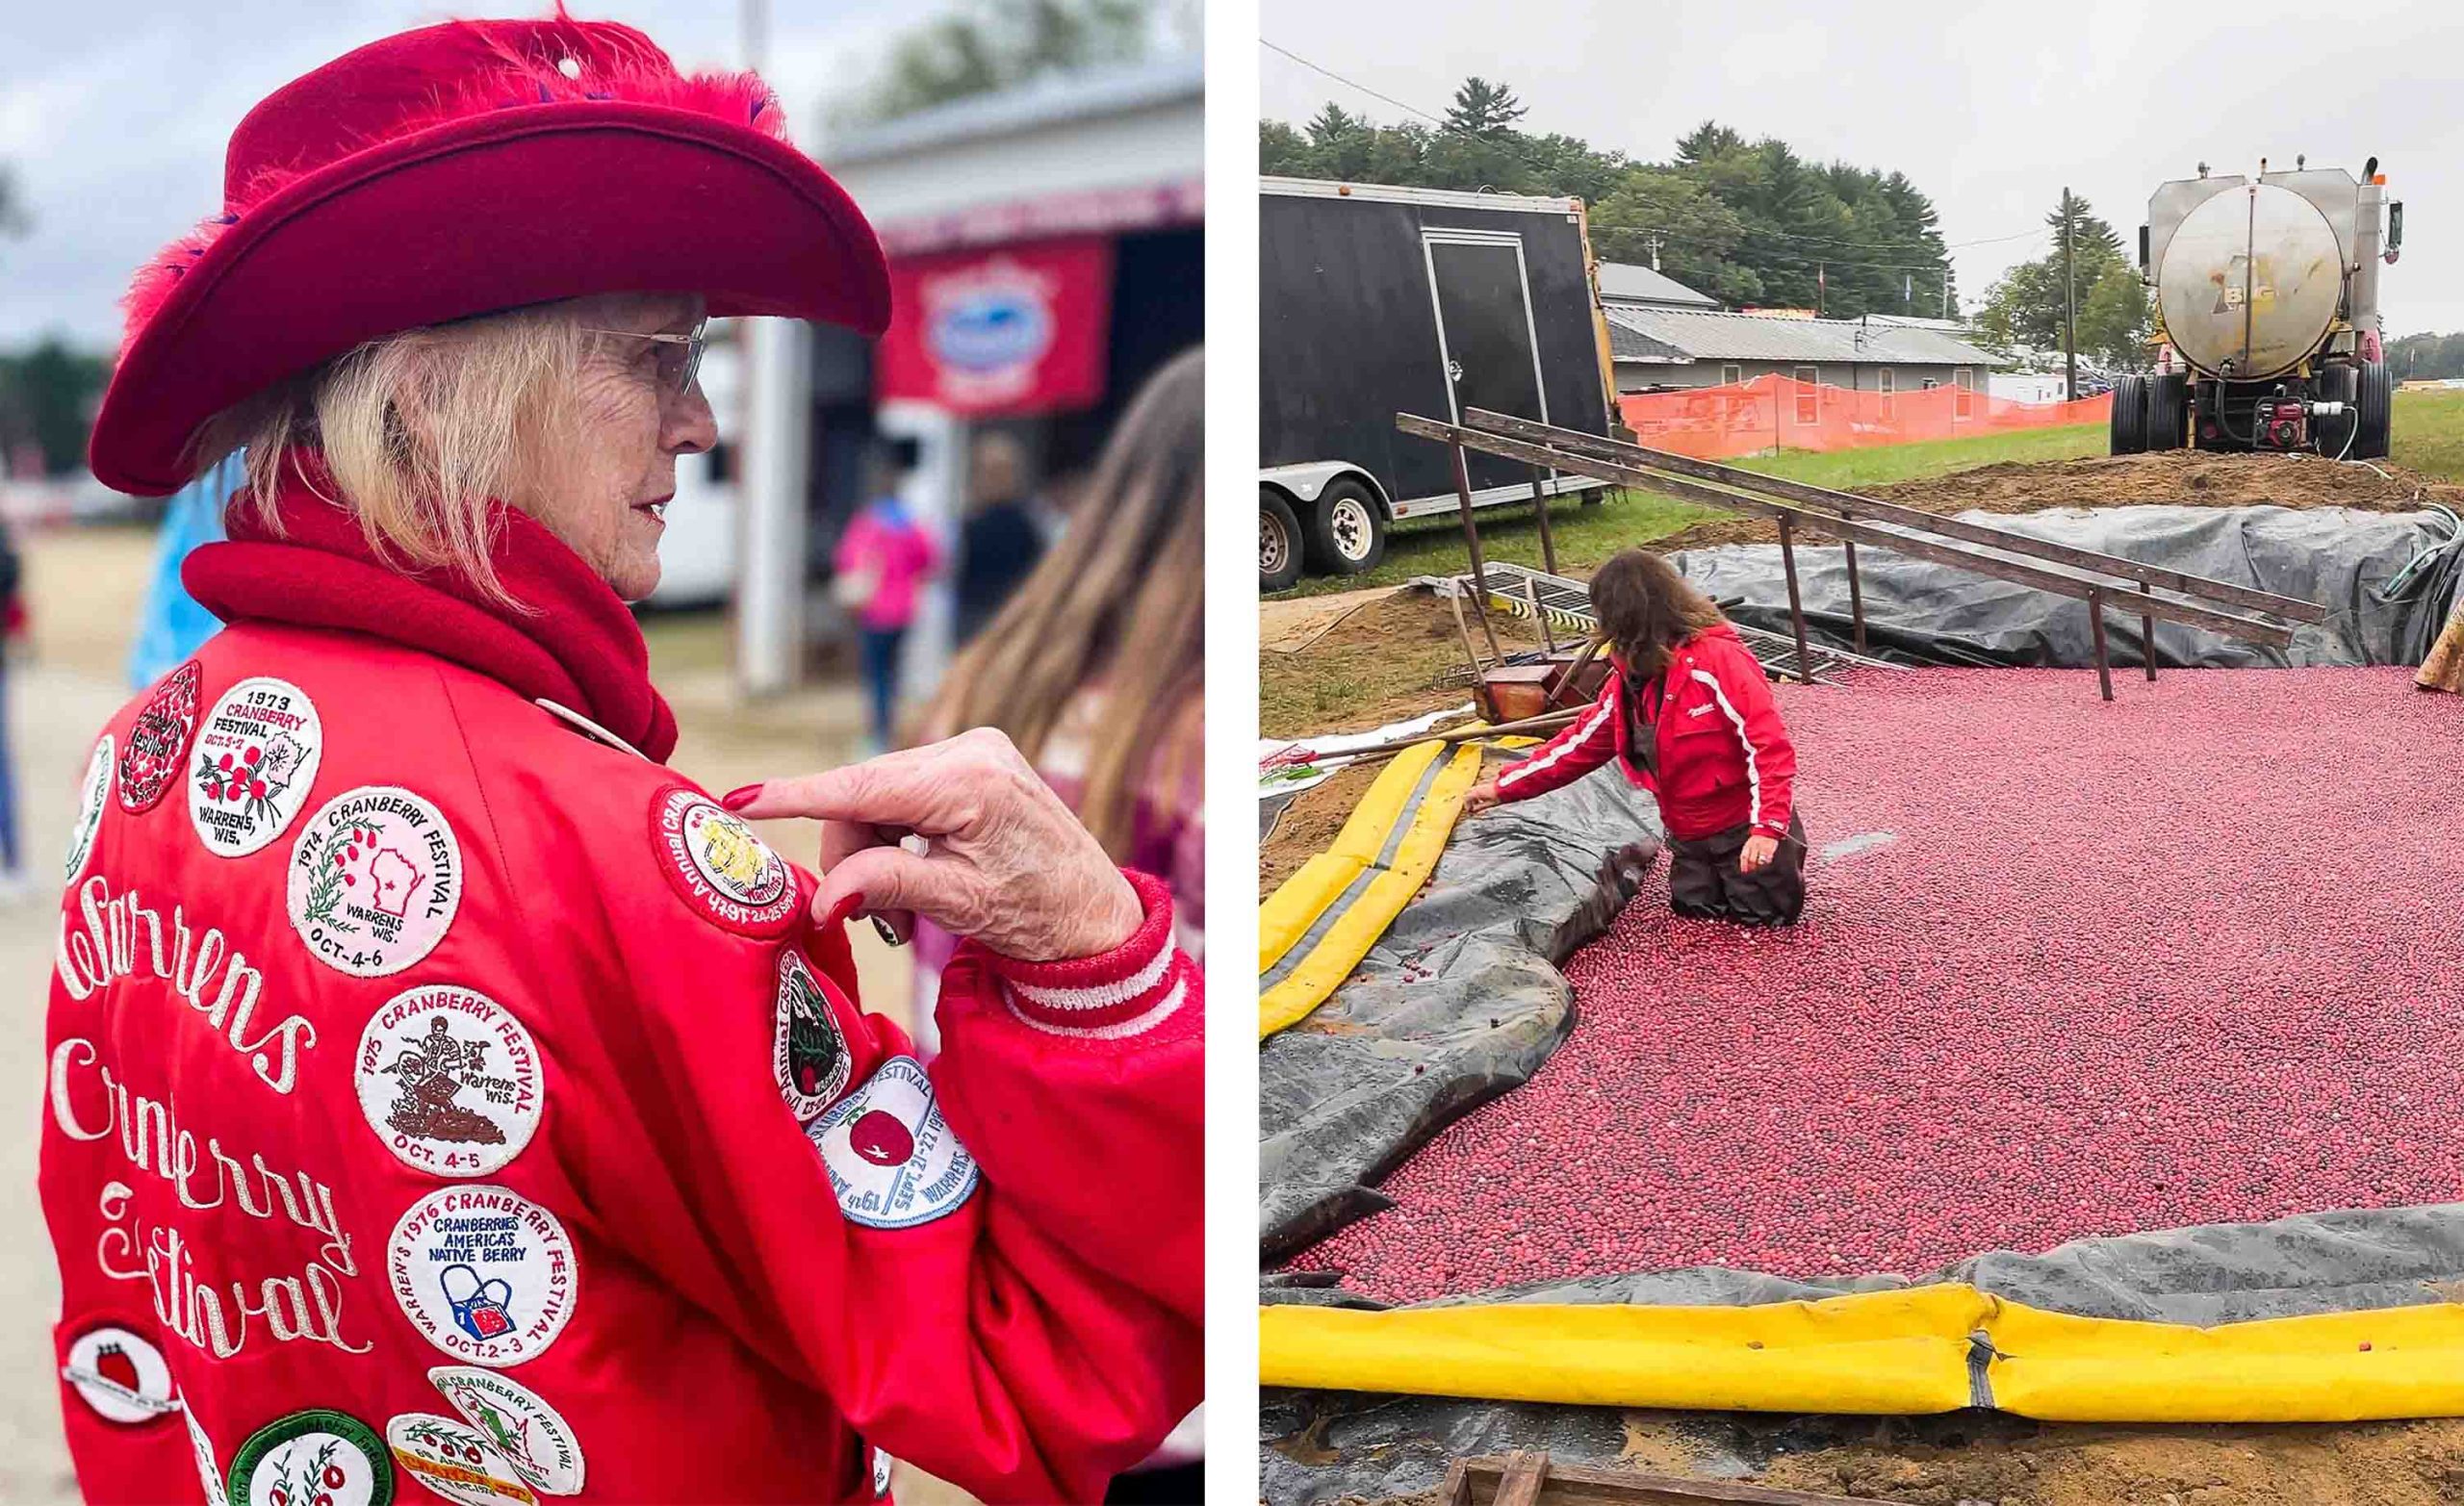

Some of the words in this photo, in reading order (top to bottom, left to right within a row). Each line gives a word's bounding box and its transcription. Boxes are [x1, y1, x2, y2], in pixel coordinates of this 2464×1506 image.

[247, 691, 290, 711] 1973
[214, 717, 268, 738] FESTIVAL
[226, 704, 307, 731] CRANBERRY
[214, 827, 241, 846] WIS.
[298, 830, 322, 867] 1974
[328, 797, 428, 828] CRANBERRY
[423, 830, 451, 919] FESTIVAL
[663, 831, 709, 898] Annual
[346, 903, 404, 932] WARRENS
[372, 927, 398, 944] WIS.
[362, 1036, 382, 1076] 1975
[381, 991, 498, 1031] CRANBERRY
[495, 1021, 534, 1114] FESTIVAL
[460, 1071, 517, 1091] Warrens
[485, 1088, 516, 1105] Wis.
[394, 1135, 436, 1165] OCT.
[445, 1153, 481, 1168] 4-5
[915, 1132, 938, 1171] 21-22
[402, 1204, 440, 1242] 1976
[433, 1216, 520, 1233] CRANBERRIES
[445, 1192, 559, 1243] CRANBERRY
[444, 1232, 515, 1248] AMERICA'S
[428, 1249, 476, 1263] NATIVE
[482, 1247, 527, 1263] BERRY
[394, 1246, 437, 1335] WARREN'S
[526, 1250, 567, 1340] FESTIVAL
[449, 1376, 536, 1412] CRANBERRY
[533, 1413, 573, 1470] FESTIVAL
